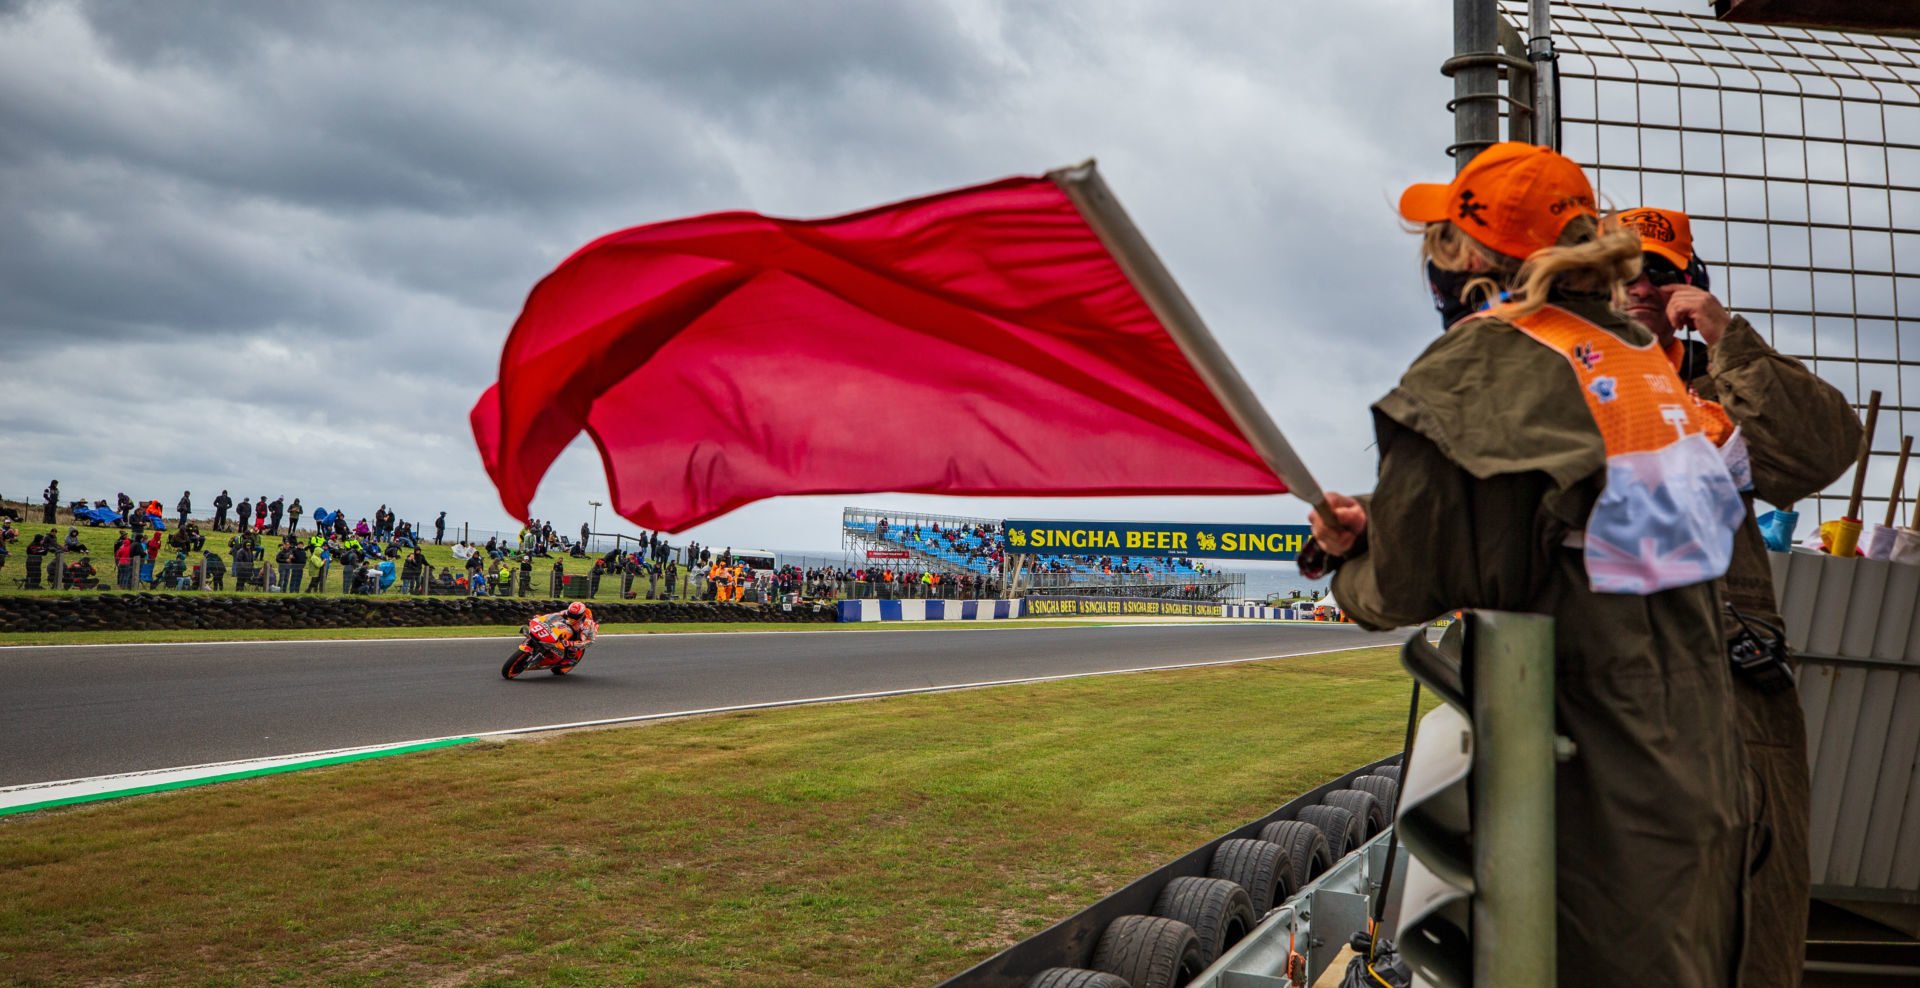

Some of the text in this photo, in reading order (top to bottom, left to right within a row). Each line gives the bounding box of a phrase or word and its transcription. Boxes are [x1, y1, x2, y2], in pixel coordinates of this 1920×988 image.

[1030, 529, 1187, 549] SINGHA BEER
[1221, 532, 1313, 552] SINGH
[1035, 600, 1076, 613] SINGHA BEER
[1085, 601, 1120, 613] SINGHA BEER
[1128, 601, 1159, 613] SINGHA BEER
[532, 625, 549, 638] 93
